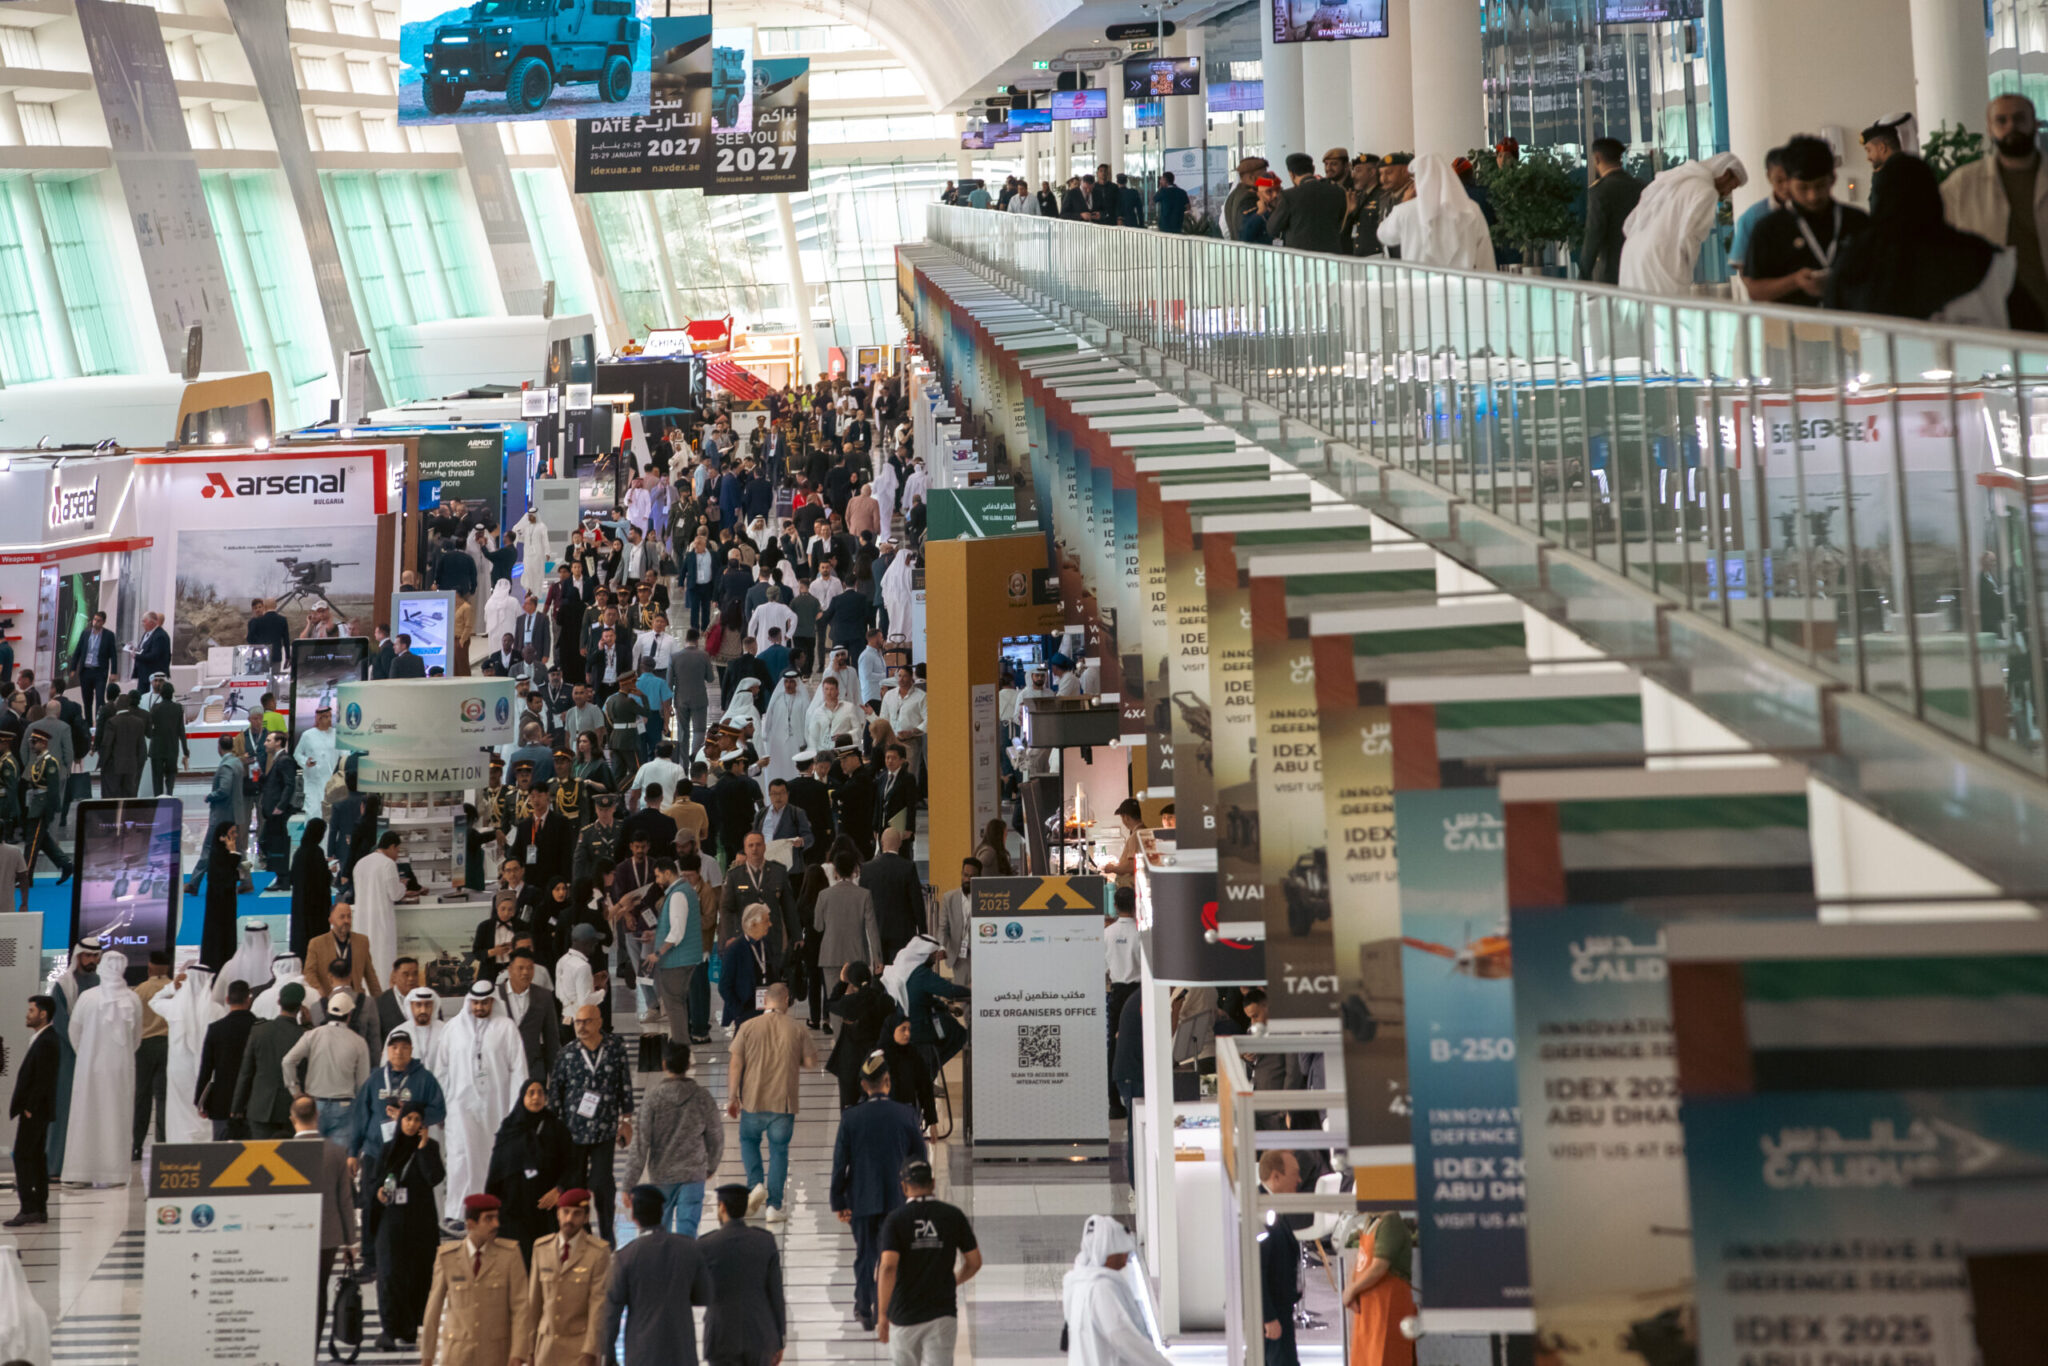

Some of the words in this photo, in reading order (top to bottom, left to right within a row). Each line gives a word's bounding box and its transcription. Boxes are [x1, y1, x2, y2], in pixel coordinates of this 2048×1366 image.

[634, 112, 702, 133] التاريخ
[758, 108, 797, 127] نراكم
[591, 120, 631, 133] DATE
[716, 134, 744, 145] SEE
[748, 131, 777, 144] YOU
[782, 130, 797, 142] IN
[590, 152, 609, 160] 25-29
[611, 151, 641, 159] JANUARY
[647, 138, 701, 156] 2027
[716, 145, 797, 173] 2027
[590, 166, 642, 176] idexuae.ae
[652, 163, 700, 173] navdex.ae
[438, 459, 477, 469] protection
[447, 468, 475, 477] threats
[236, 467, 345, 496] arsenal
[63, 474, 99, 521] arsenal
[1, 554, 35, 564] Weapons
[1272, 743, 1316, 758] IDEX
[376, 766, 482, 783] INFORMATION
[1273, 761, 1307, 773] ABU
[1274, 783, 1304, 793] VISIT
[1345, 826, 1396, 843] IDEX
[1345, 846, 1386, 861] ABU
[1347, 872, 1383, 884] VISIT
[979, 898, 1010, 911] 2025
[113, 935, 149, 945] MILO
[1571, 957, 1668, 983] CALID
[1060, 990, 1086, 1001] مكتب
[979, 1008, 1001, 1018] IDEX
[1003, 1007, 1063, 1017] ORGANISERS
[1064, 1007, 1097, 1017] OFFICE
[1430, 1037, 1516, 1063] B-250
[1540, 1040, 1642, 1062] DEFENCE
[1544, 1076, 1618, 1099] IDEX
[1547, 1104, 1605, 1128] ABU
[1431, 1128, 1519, 1146] DEFENCE
[1548, 1143, 1597, 1161] VISIT
[1602, 1142, 1628, 1160] US
[1433, 1157, 1496, 1180] IDEX
[159, 1172, 200, 1189] 2025
[1435, 1180, 1484, 1201] ABU
[1434, 1213, 1475, 1229] VISIT
[1479, 1212, 1503, 1228] US
[1725, 1270, 1859, 1291] DEFENCE
[1733, 1314, 1827, 1344] IDEX
[1839, 1312, 1932, 1343] 2025
